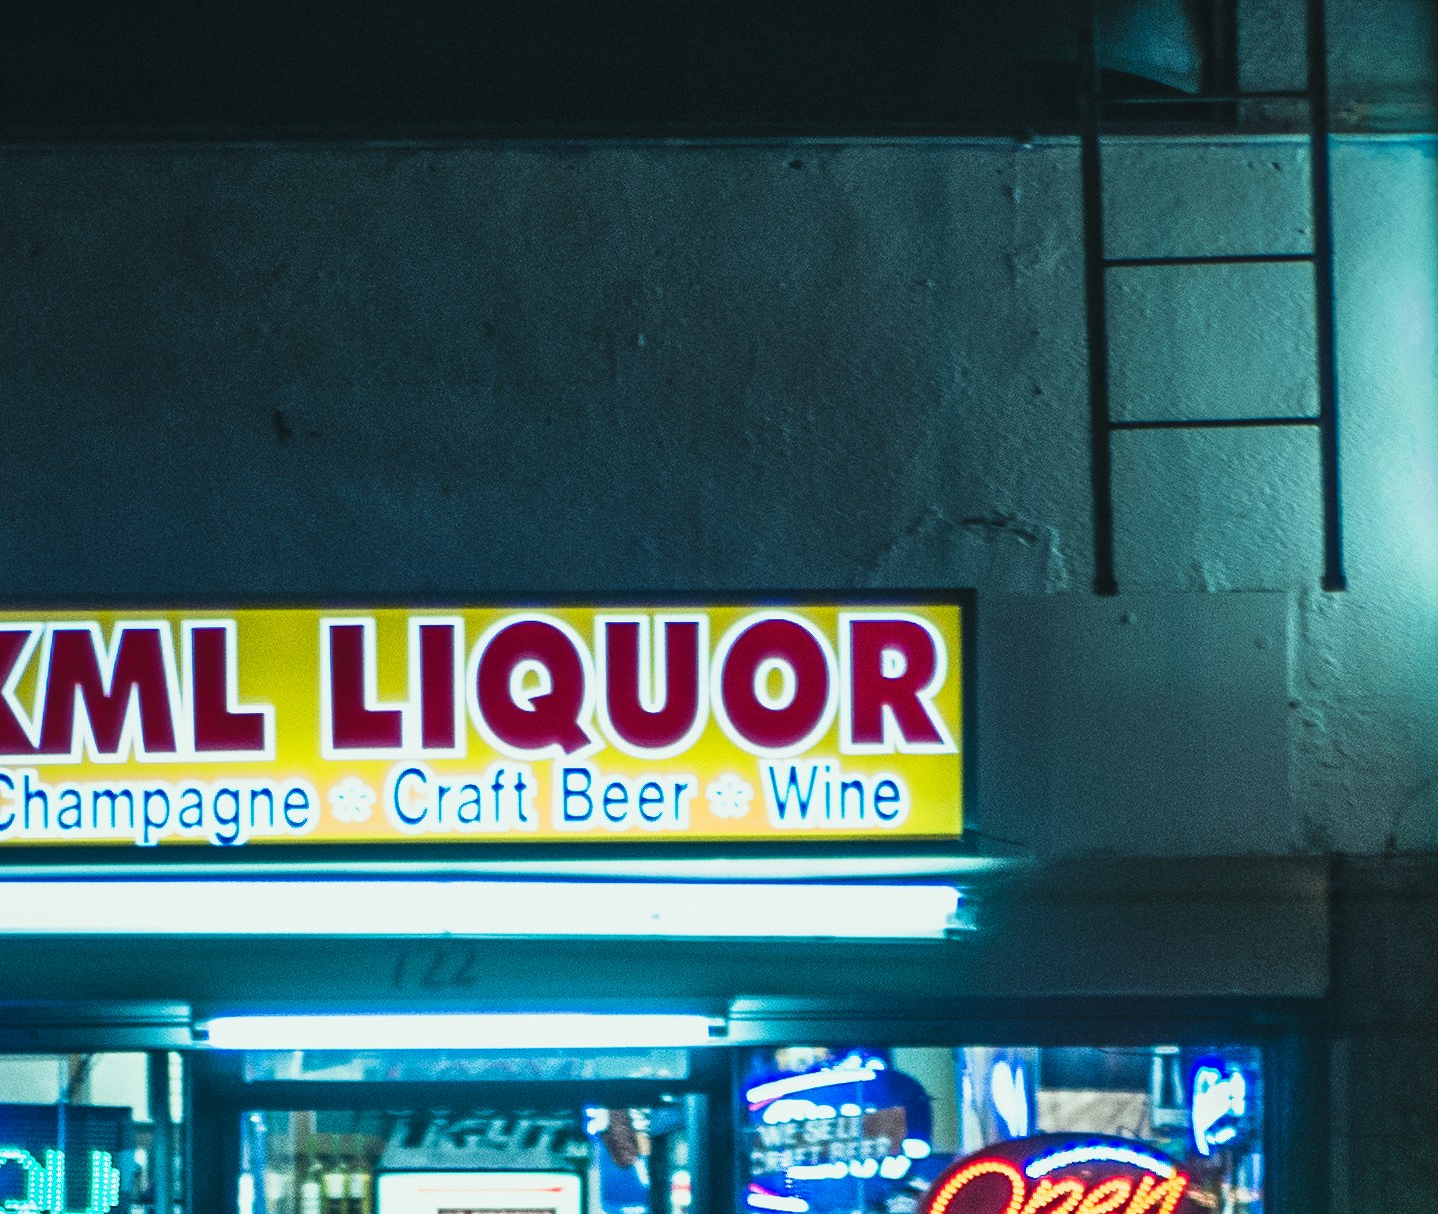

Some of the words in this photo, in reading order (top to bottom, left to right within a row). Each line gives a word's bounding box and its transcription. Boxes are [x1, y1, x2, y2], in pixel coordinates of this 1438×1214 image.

[327, 618, 947, 757] LIQUOR
[393, 767, 530, 826] Craft
[561, 767, 689, 822] Beer
[768, 765, 903, 821] Wine
